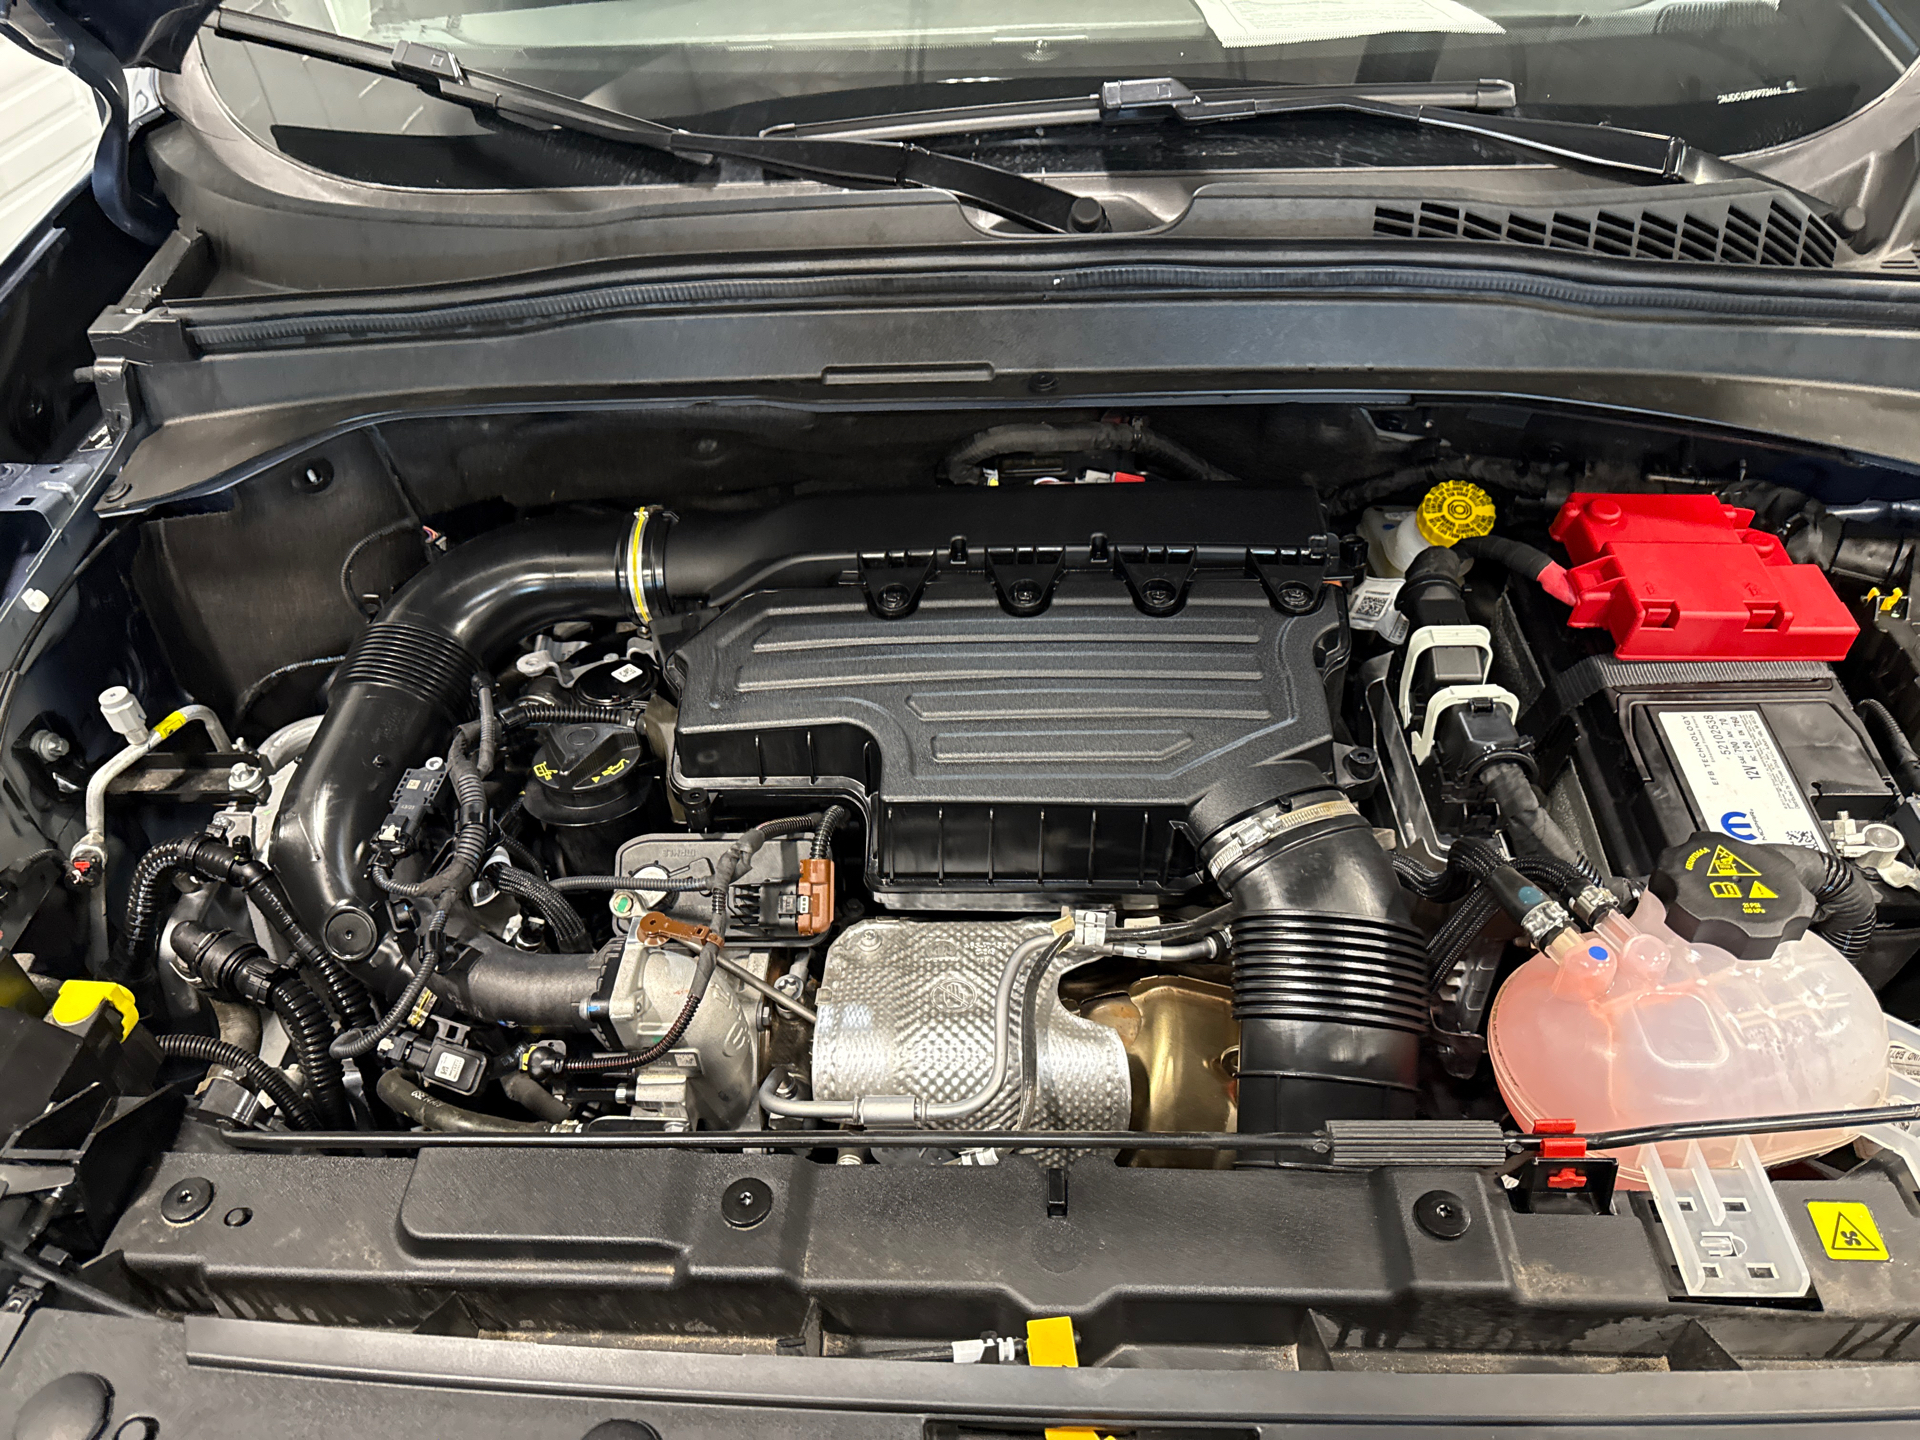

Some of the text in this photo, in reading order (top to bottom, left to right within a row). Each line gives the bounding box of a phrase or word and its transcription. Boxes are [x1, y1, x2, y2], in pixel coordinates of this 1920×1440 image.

[1702, 714, 1731, 754] 52102538
[1681, 715, 1719, 785] EFB TECHNOLOGY
[1729, 741, 1742, 752] 700
[1741, 741, 1754, 752] 120
[1737, 755, 1747, 763] SAE
[1741, 765, 1762, 779] 12V
